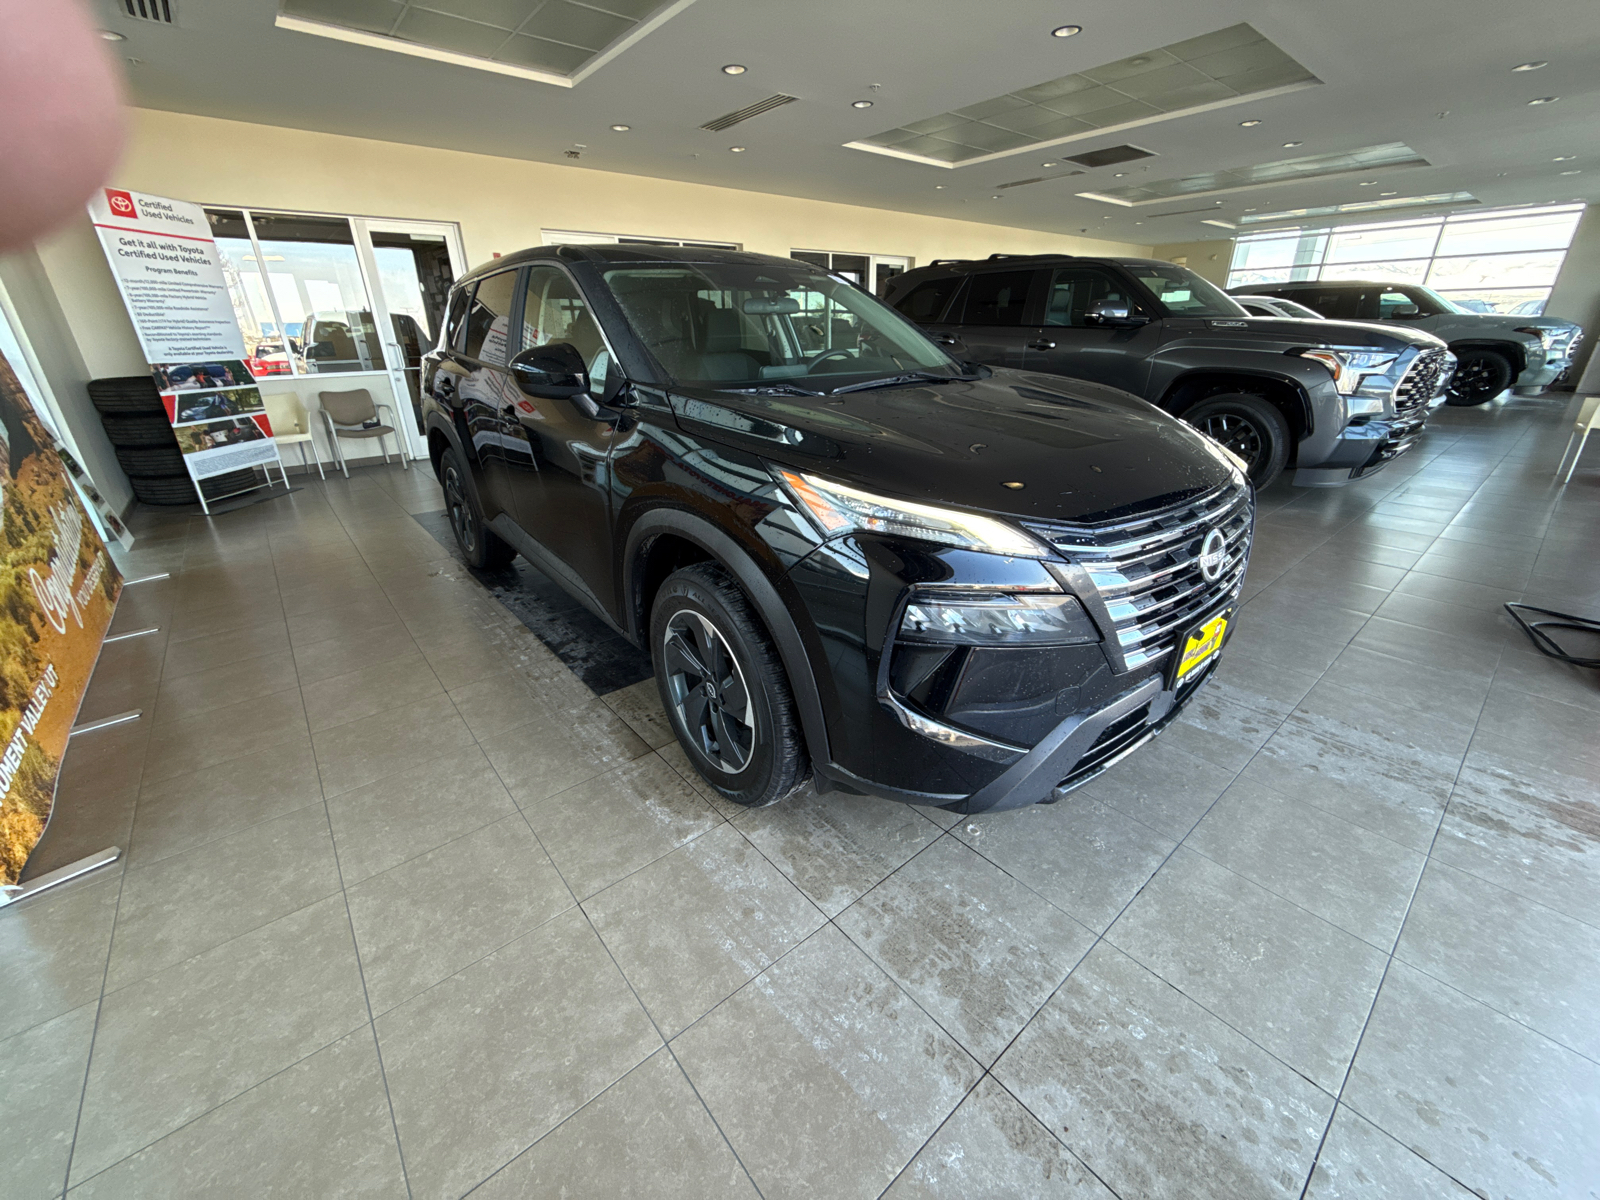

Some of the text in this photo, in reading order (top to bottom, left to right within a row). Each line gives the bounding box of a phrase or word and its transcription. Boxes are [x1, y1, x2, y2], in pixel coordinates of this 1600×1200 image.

[138, 199, 173, 212] Certified
[141, 209, 194, 225] Used Vehicles
[118, 237, 205, 256] Get it all with Toyota
[118, 248, 212, 266] Certified Used Vehicles
[145, 266, 199, 276] Program Benefits
[20, 680, 53, 736] VALLEY,
[45, 663, 59, 688] UT
